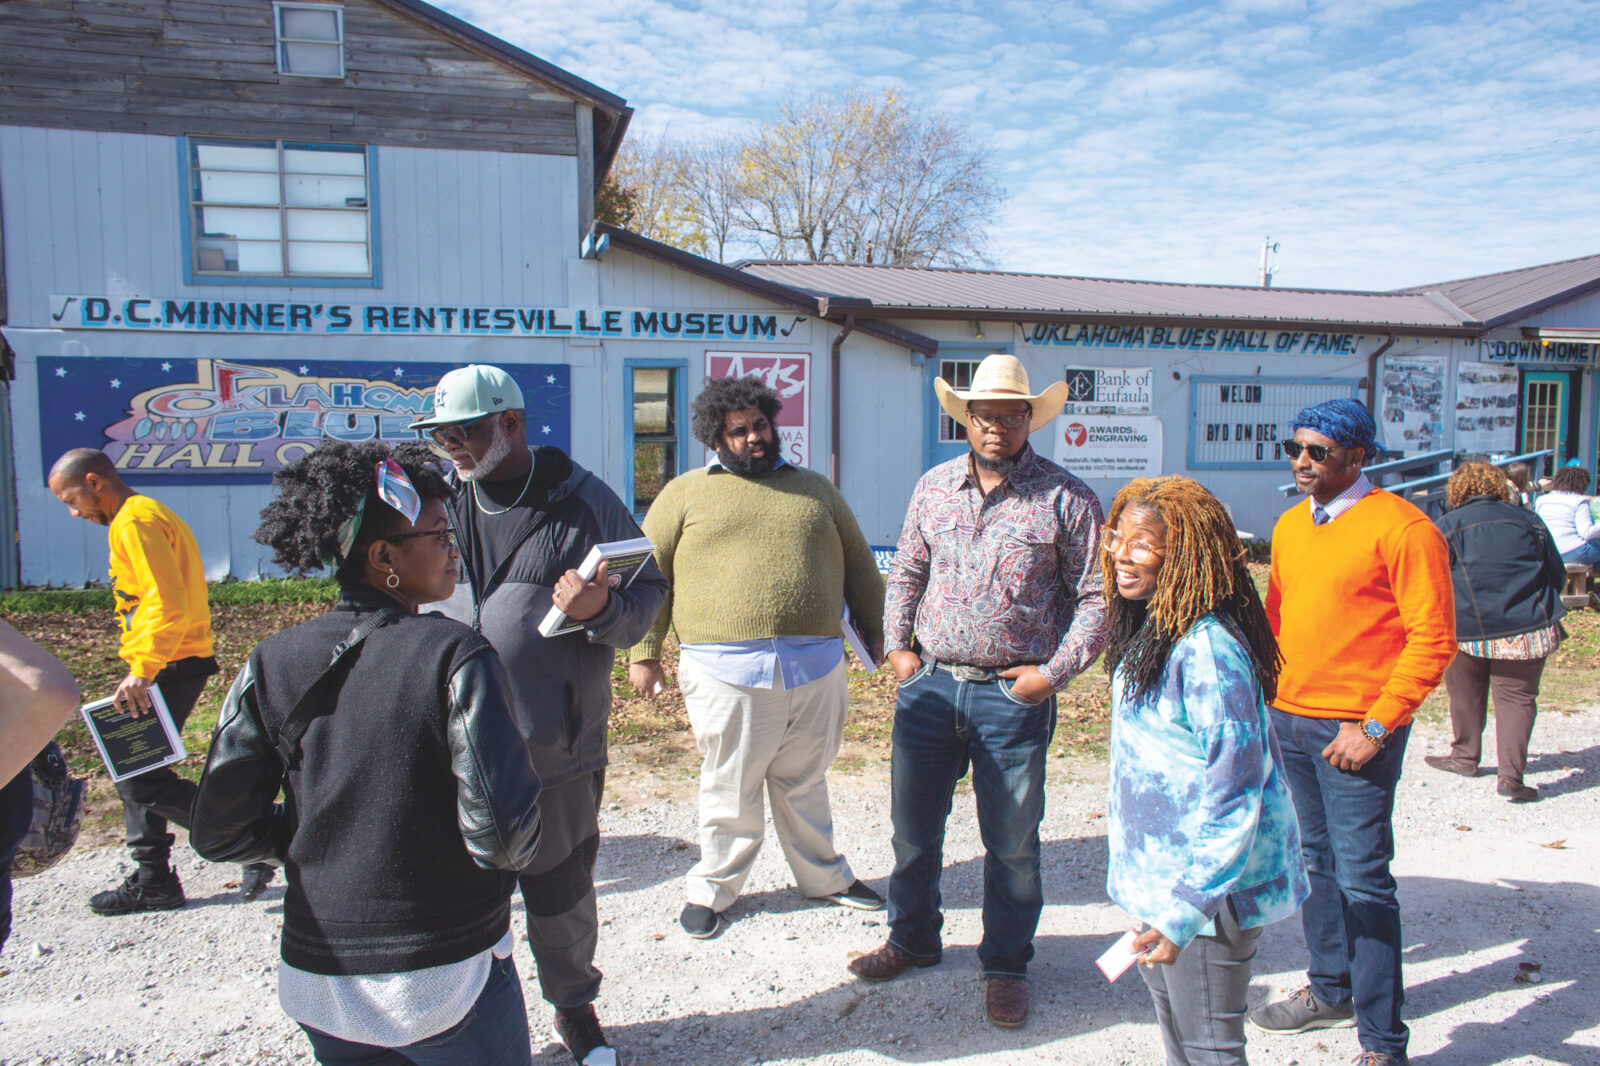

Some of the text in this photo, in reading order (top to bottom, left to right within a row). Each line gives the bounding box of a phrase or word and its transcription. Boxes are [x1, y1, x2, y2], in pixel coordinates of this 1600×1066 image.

[363, 305, 623, 338] RENTIESVILLE
[631, 311, 778, 341] MUSEUM
[1032, 323, 1354, 355] OKLAHOMA BLUES HALL OF FAME
[1494, 341, 1541, 360] DOWN
[1545, 342, 1589, 361] HOME
[1096, 369, 1152, 386] Bank of
[1096, 386, 1149, 403] Eufaula
[202, 409, 437, 442] BLUE
[1089, 426, 1133, 434] AWARDS
[1256, 424, 1277, 441] DEC
[1089, 435, 1148, 443] ENGRAVING
[114, 443, 265, 469] HALL
